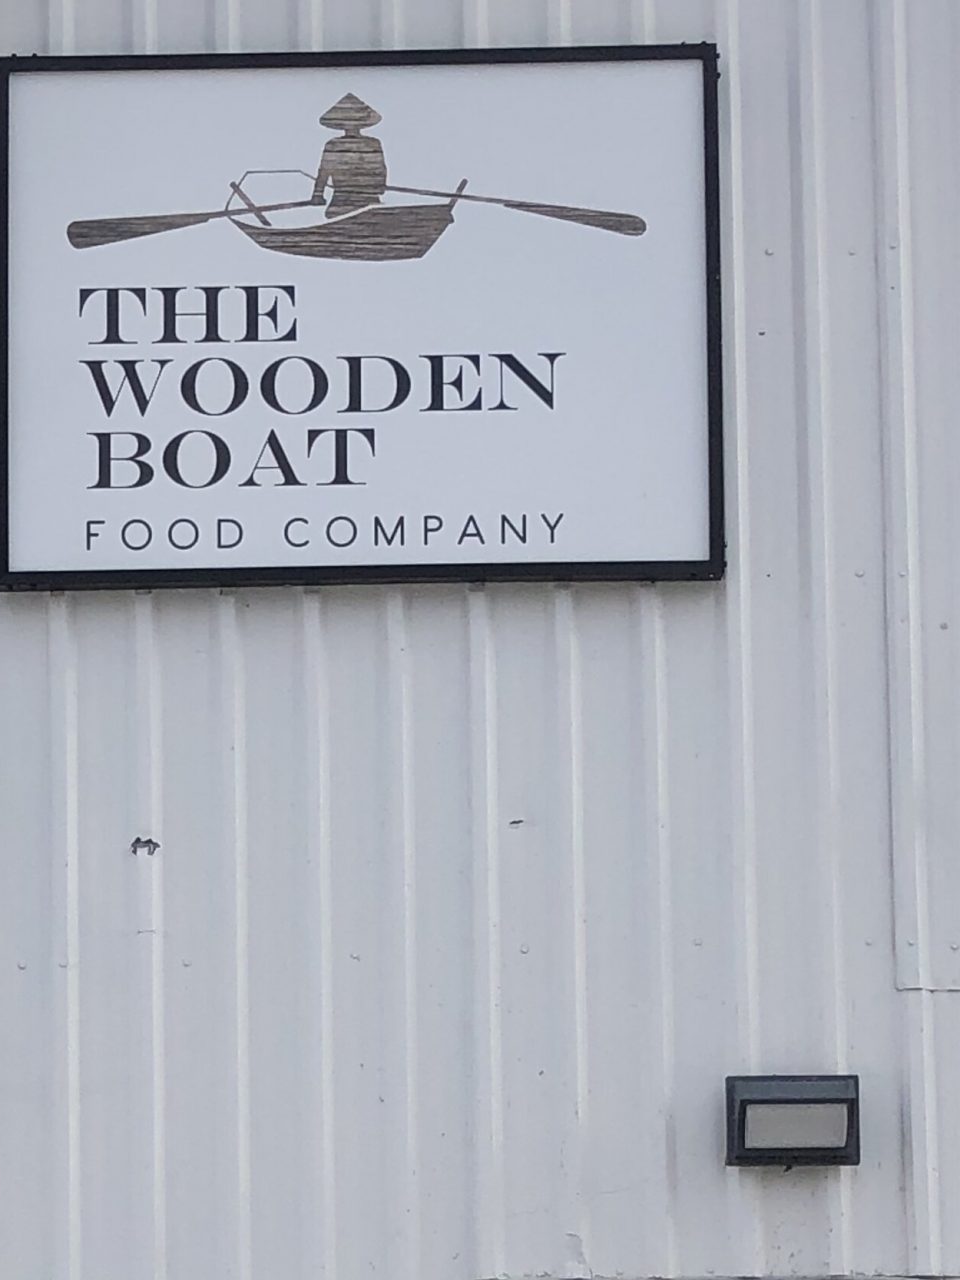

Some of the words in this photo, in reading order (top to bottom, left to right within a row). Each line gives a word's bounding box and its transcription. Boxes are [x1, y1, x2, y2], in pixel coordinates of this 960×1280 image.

[78, 284, 298, 345] THE
[78, 353, 566, 418] WOODEN
[86, 428, 376, 489] BOAT
[86, 519, 244, 551] FOOD
[283, 513, 565, 549] COMPANY
